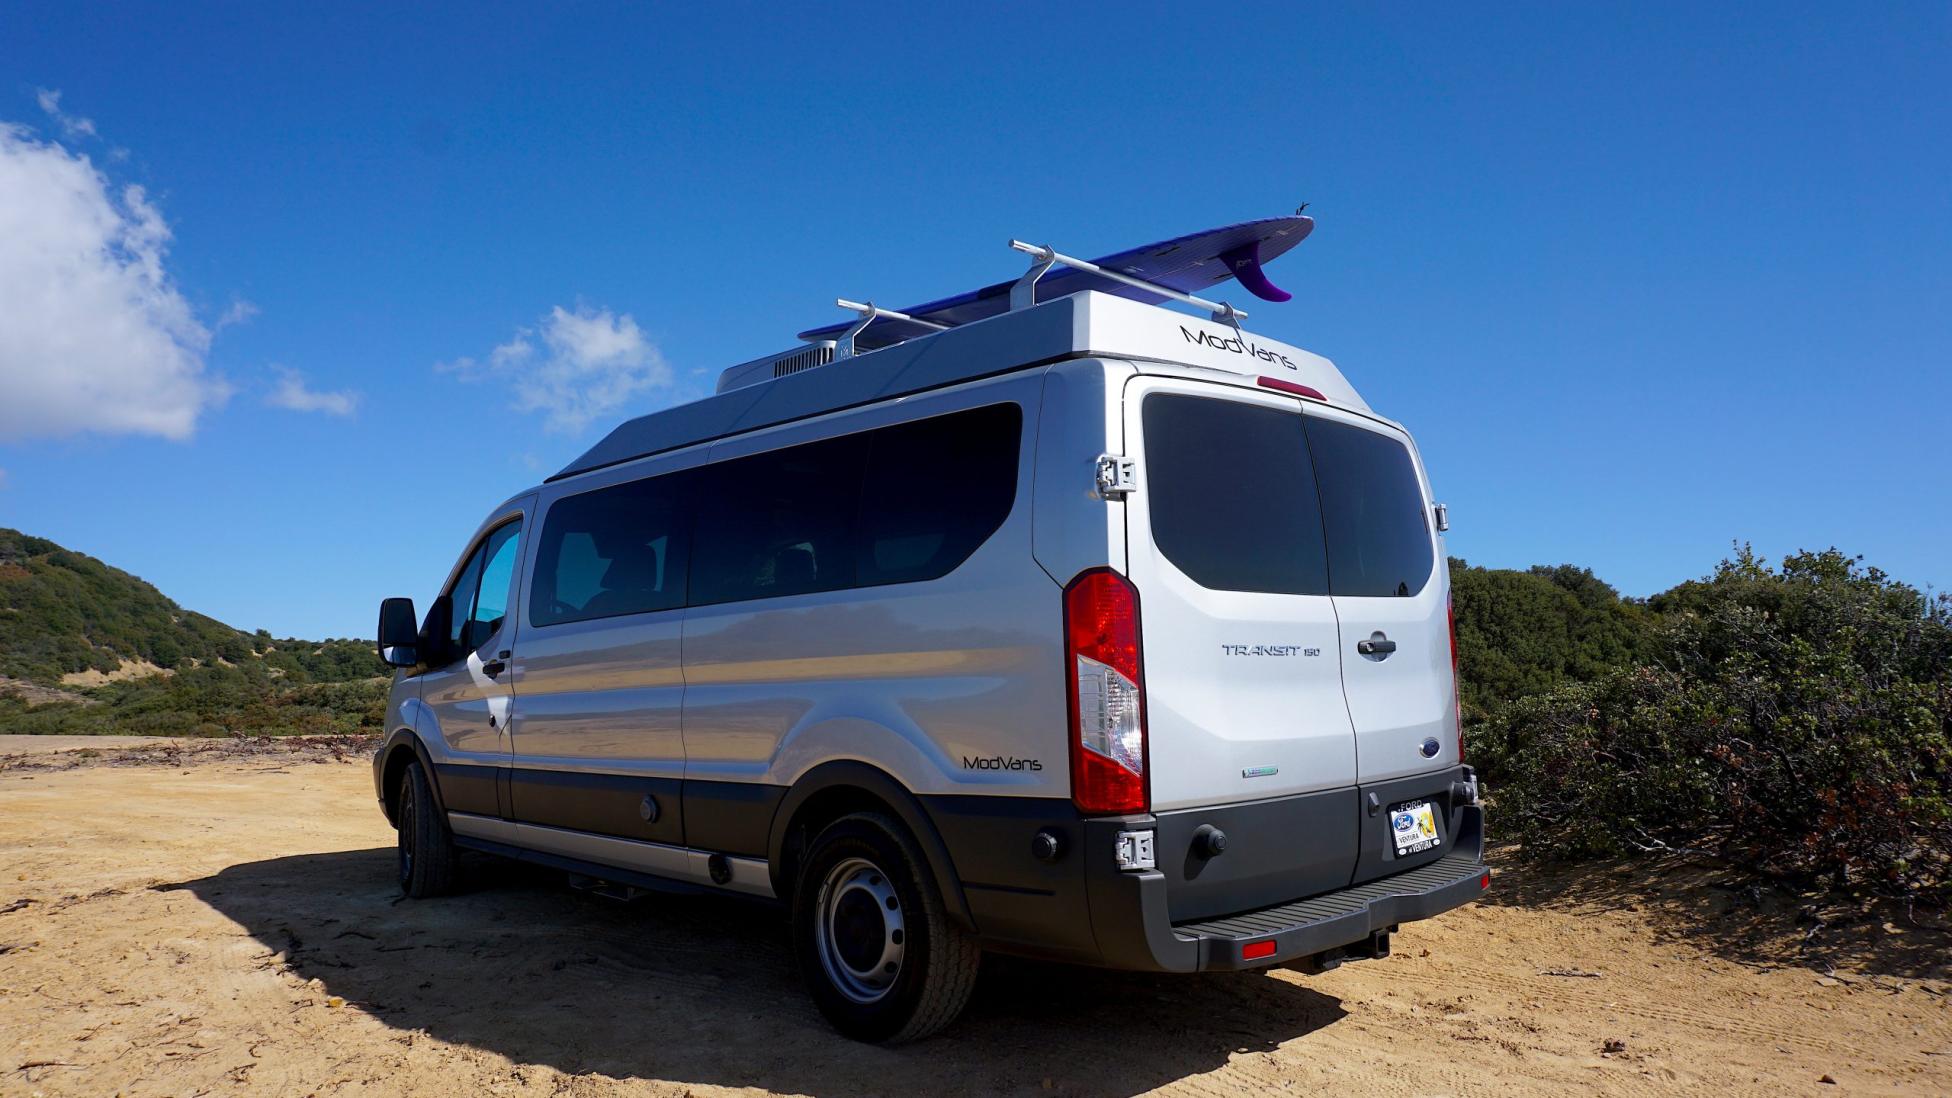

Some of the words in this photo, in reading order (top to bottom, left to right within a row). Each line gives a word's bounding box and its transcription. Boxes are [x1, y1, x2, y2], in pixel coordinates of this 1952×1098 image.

[1179, 325, 1298, 371] ModVans
[1221, 644, 1301, 657] TRANSIT
[1303, 647, 1320, 657] 150
[963, 755, 1042, 771] ModVans
[1400, 800, 1422, 810] FORD
[1399, 833, 1419, 844] VENTURA
